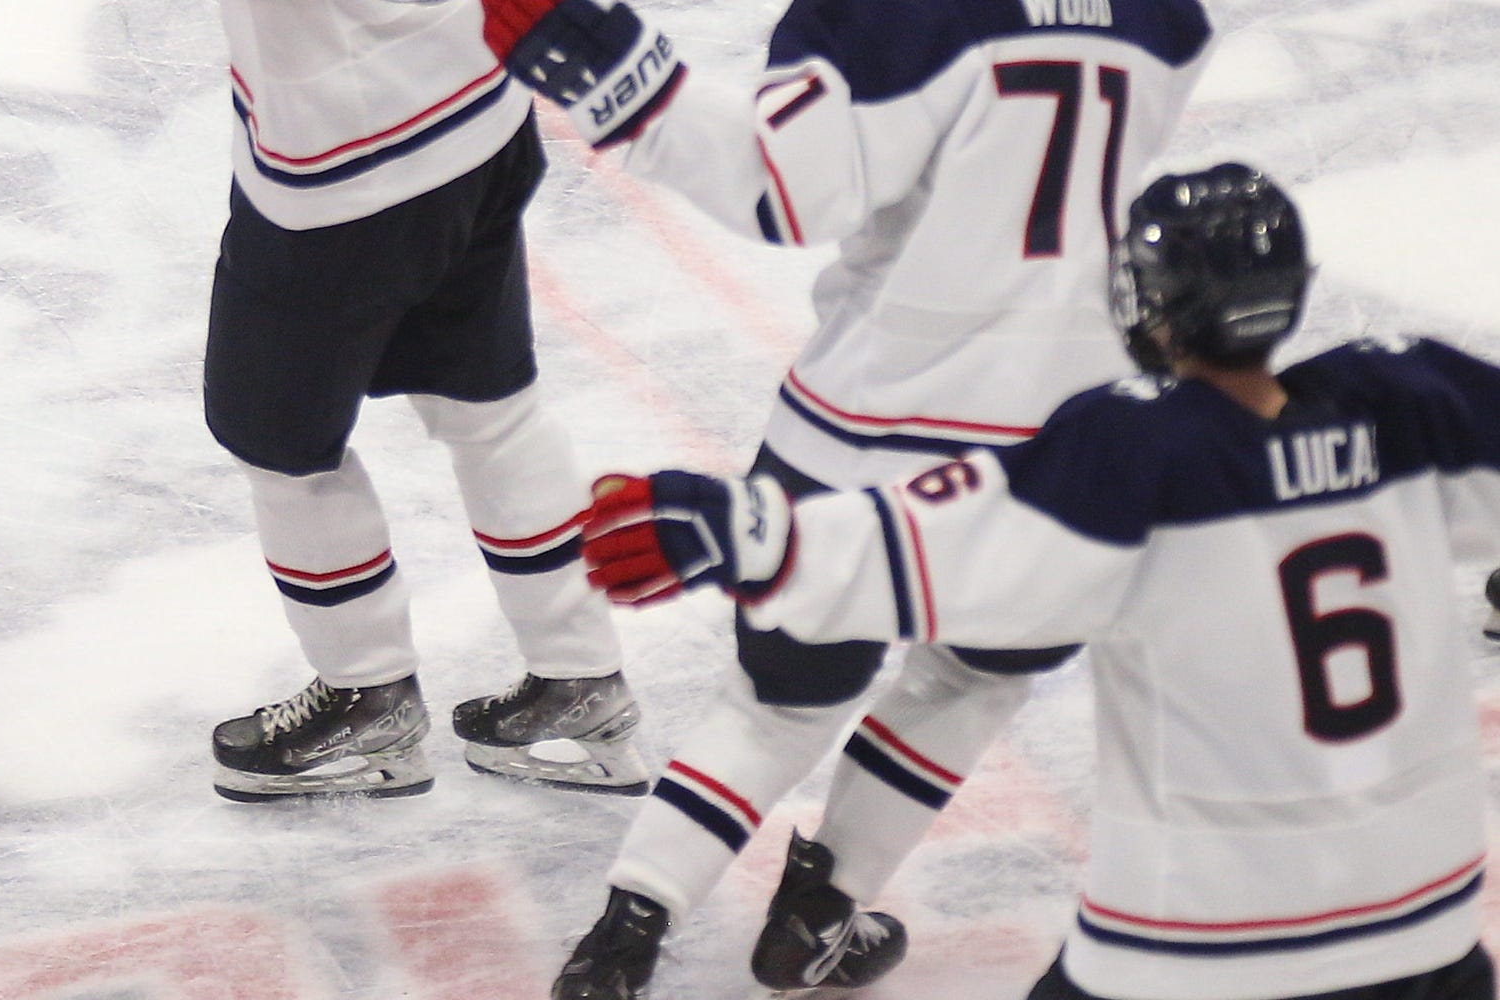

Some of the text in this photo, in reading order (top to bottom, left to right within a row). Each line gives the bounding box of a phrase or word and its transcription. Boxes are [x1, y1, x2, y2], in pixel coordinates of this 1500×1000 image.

[993, 59, 1130, 262] 71
[906, 460, 982, 505] 6
[1277, 531, 1407, 746] 6
